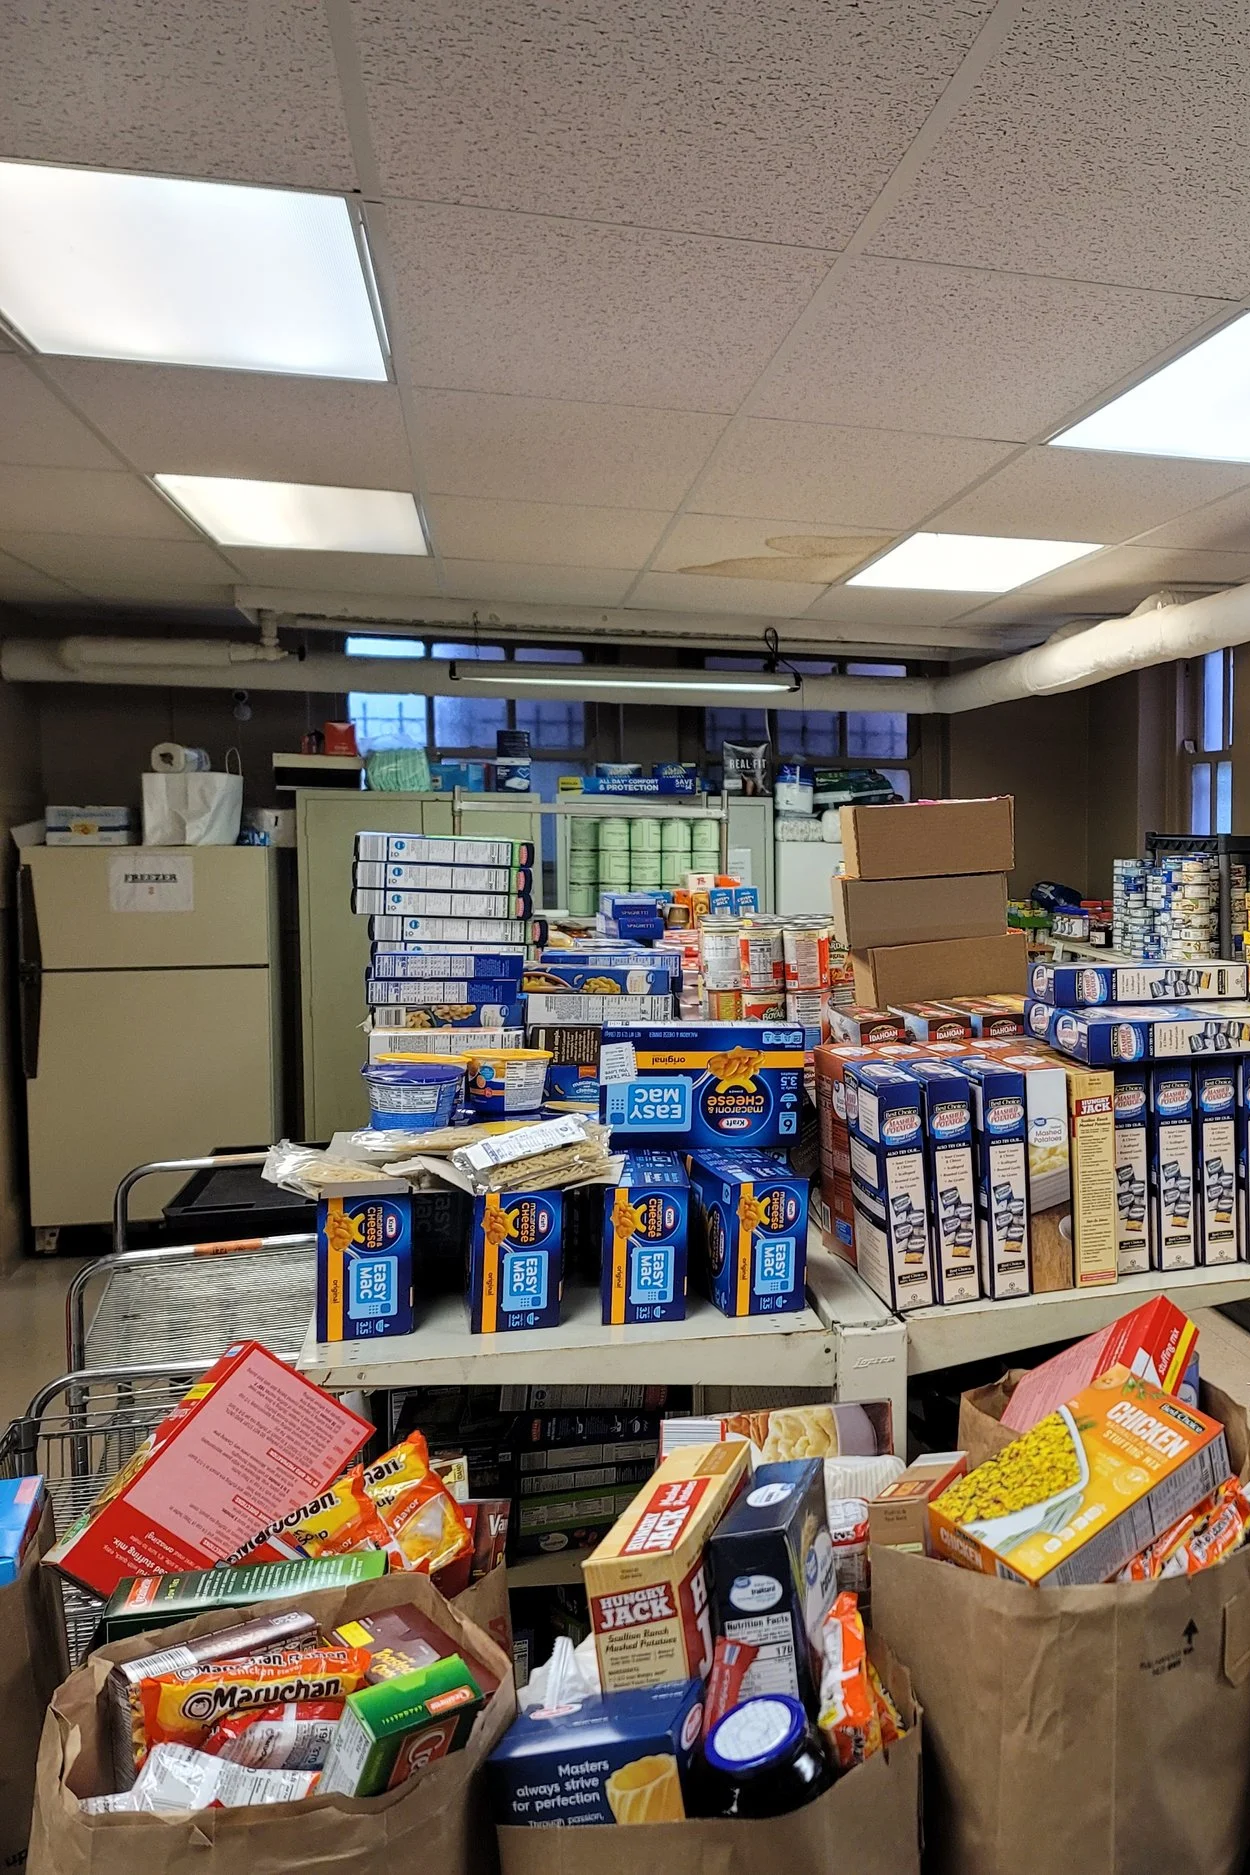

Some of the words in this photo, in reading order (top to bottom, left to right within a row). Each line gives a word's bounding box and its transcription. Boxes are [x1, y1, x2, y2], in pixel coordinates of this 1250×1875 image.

[729, 759, 751, 769] REAL
[753, 759, 766, 769] FIT
[124, 873, 178, 883] FREEZER
[869, 1029, 899, 1042] IDAHOAN
[936, 1028, 966, 1041] IDAHOAN
[989, 1024, 1018, 1037] IDAHOAN
[652, 1056, 686, 1066] original
[780, 1076, 798, 1086] 3.5
[1170, 1081, 1189, 1089] Choice
[635, 1088, 679, 1103] Mac
[715, 1106, 763, 1114] macaroni
[947, 1102, 967, 1110] Choice
[993, 1105, 1018, 1116] MASHED
[1080, 1103, 1112, 1115] JACK
[886, 1110, 899, 1118] Best
[939, 1110, 965, 1121] MASHED
[991, 1111, 1021, 1123] POTATOES
[724, 1119, 745, 1127] Kraft
[783, 1119, 793, 1131] 6
[886, 1122, 918, 1135] POTATOES
[888, 1116, 915, 1128] MASHED
[936, 1116, 967, 1129] POTATOES
[1035, 1128, 1063, 1137] Mashed
[763, 1246, 775, 1277] Mac
[512, 1261, 525, 1292] Mac
[640, 1255, 652, 1286] Mac
[359, 1267, 372, 1299] Mac
[762, 1297, 771, 1310] 3.5
[639, 1306, 647, 1319] 3.5
[511, 1313, 520, 1327] 3.5
[360, 1321, 369, 1334] 3.5
[1158, 1343, 1176, 1376] stuffing
[1170, 1327, 1180, 1345] mix
[1160, 1403, 1179, 1419] Best
[1177, 1413, 1204, 1433] Choice
[1106, 1400, 1190, 1460] CHICKEN
[1103, 1429, 1144, 1459] STUFFING
[394, 1500, 420, 1529] Flavor
[110, 1536, 129, 1552] mix.
[144, 1529, 175, 1556] amazing!
[938, 1526, 983, 1569] CHICKEN
[126, 1545, 156, 1571] stuffing
[599, 1585, 666, 1610] HUNGRY
[601, 1596, 675, 1630] JACK
[727, 1618, 764, 1632] Nutrition
[766, 1615, 790, 1626] Facts
[605, 1642, 638, 1654] Mashed
[776, 1645, 793, 1656] 170
[212, 1679, 340, 1710] Maruchan
[557, 1759, 610, 1778] Masters
[516, 1779, 561, 1800] always
[563, 1776, 600, 1793] strive
[512, 1799, 532, 1814] for
[534, 1791, 600, 1815] perfection
[568, 1812, 605, 1825] passion,
